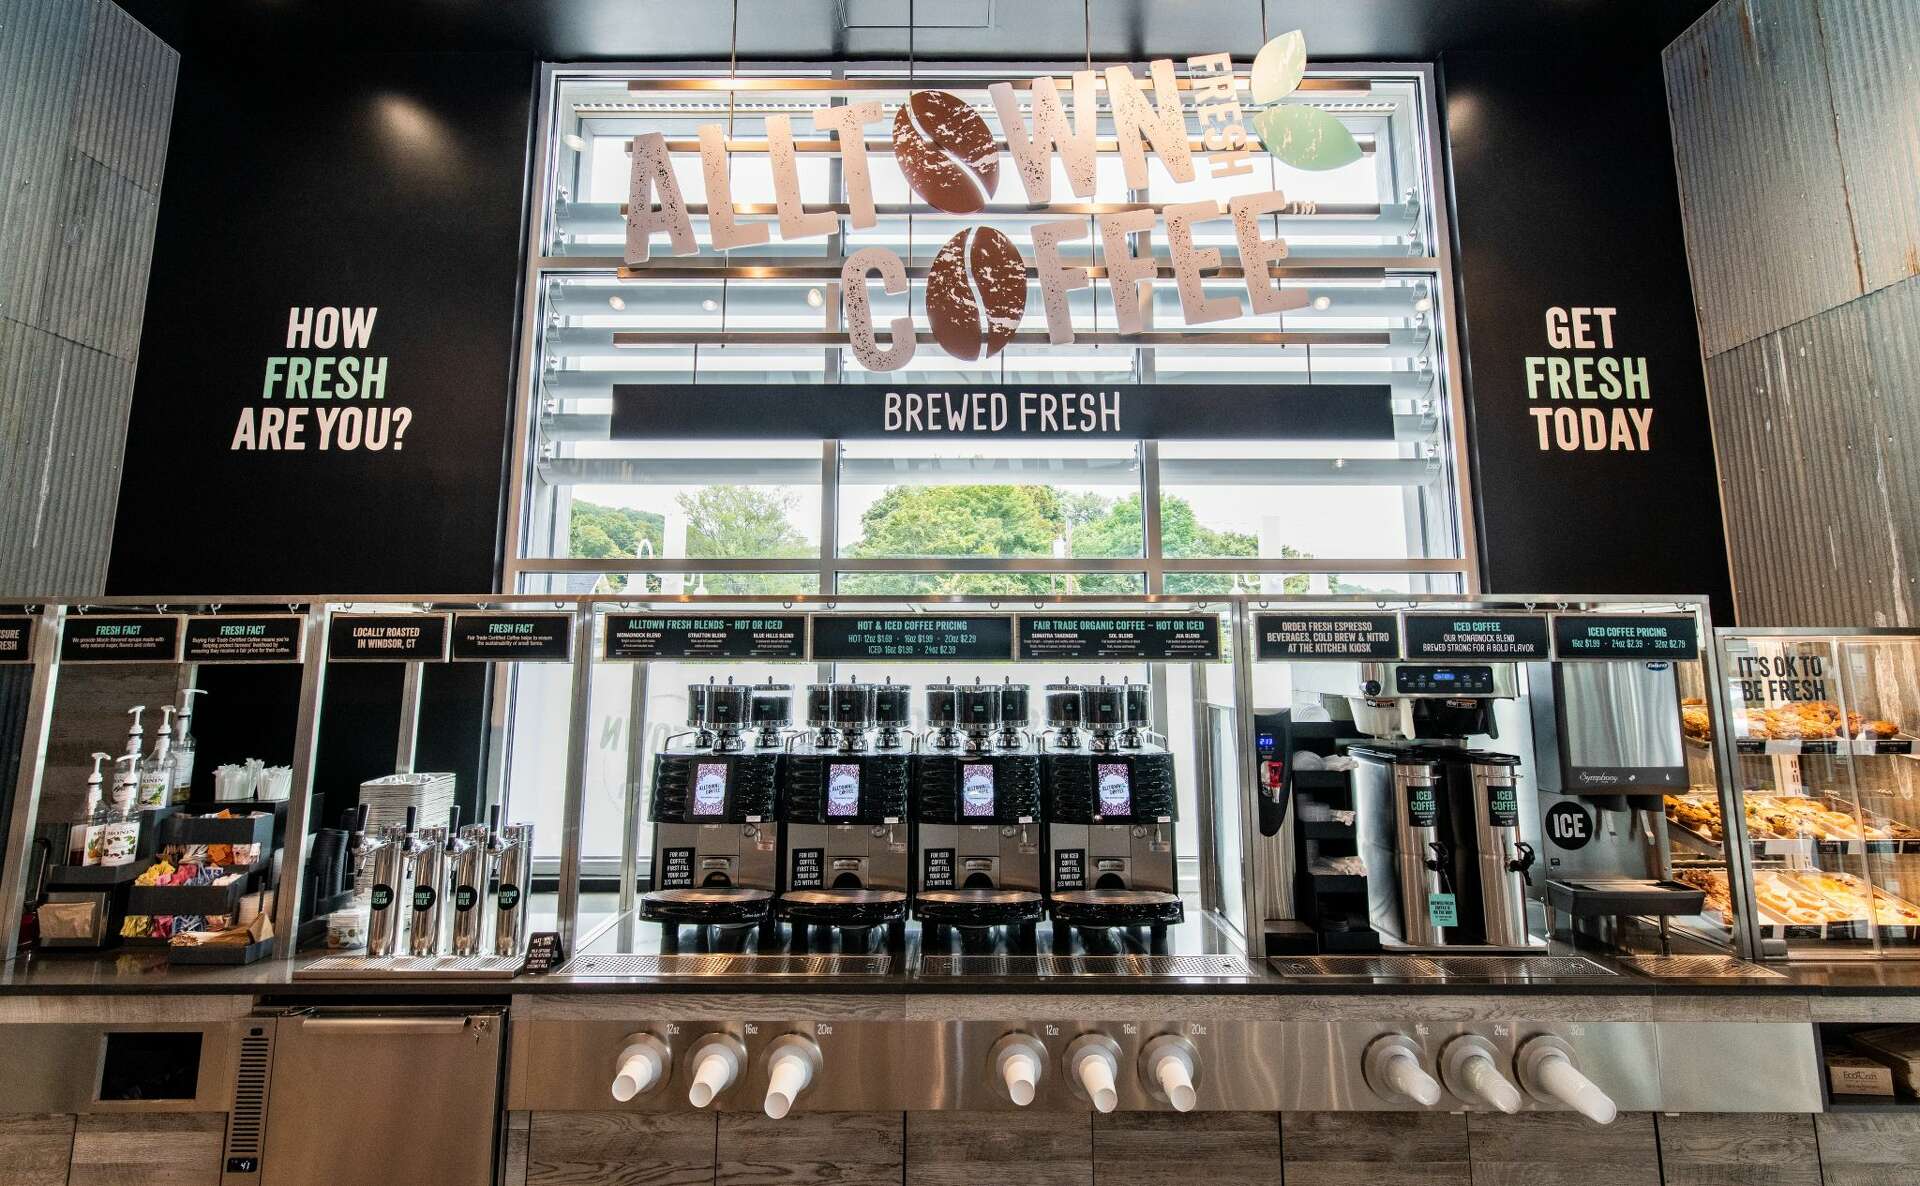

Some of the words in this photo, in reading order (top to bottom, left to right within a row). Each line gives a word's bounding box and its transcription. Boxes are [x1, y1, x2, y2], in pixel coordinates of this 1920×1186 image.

[286, 306, 378, 349] HOW
[1545, 306, 1617, 349] GET
[262, 356, 388, 399] FRESH
[1525, 356, 1650, 400] FRESH
[884, 392, 1008, 432] BREWED
[1020, 392, 1120, 432] FRESH
[230, 407, 309, 451] ARE
[316, 407, 412, 451] YOU?
[1529, 407, 1653, 451] TODAY
[220, 625, 245, 635] FRESH
[246, 625, 266, 635] FACT
[488, 623, 513, 633] FRESH
[515, 623, 534, 633] FACT
[628, 619, 665, 630] ALLTOWN
[666, 619, 692, 630] FRESH
[694, 619, 725, 630] BLENDS
[734, 619, 750, 630] HOT
[752, 619, 763, 630] OR
[764, 619, 783, 630] ICED
[857, 621, 873, 631] HOT
[875, 621, 882, 631] &
[884, 621, 903, 631] ICED
[904, 621, 933, 631] COFFEE
[935, 621, 967, 631] PRICING
[1033, 620, 1051, 630] FAIR
[1053, 620, 1078, 630] TRADE
[1079, 620, 1115, 630] ORGANIC
[1116, 620, 1146, 630] COFFEE
[1156, 620, 1172, 630] HOT
[1173, 620, 1184, 630] OR
[1186, 620, 1205, 630] ICED
[1281, 622, 1307, 632] ORDER
[1308, 622, 1332, 632] FRESH
[1334, 622, 1372, 632] ESPRESSO
[1453, 622, 1471, 632] ICED
[1472, 622, 1501, 632] COFFEE
[96, 626, 120, 635] FRESH
[122, 626, 142, 635] FACT
[353, 627, 385, 637] LOCALLY
[386, 627, 420, 637] ROASTED
[1587, 627, 1606, 637] ICED
[1606, 627, 1635, 637] COFFEE
[1636, 627, 1668, 637] PRICING
[864, 634, 876, 643] 12oz
[1266, 632, 1311, 642] BEVERAGES,
[1312, 632, 1332, 642] COLD
[1334, 632, 1355, 642] BREW
[1358, 632, 1365, 642] &
[1366, 632, 1389, 642] NITRO
[1443, 634, 1456, 643] OUR
[1496, 634, 1515, 643] BLEND
[357, 639, 366, 649] IN
[367, 639, 405, 649] WINDSOR,
[406, 639, 416, 649] CT
[925, 645, 938, 654] 24oz
[1287, 643, 1296, 653] AT
[1299, 643, 1313, 653] THE
[1315, 643, 1347, 653] KITCHEN
[1348, 643, 1371, 653] KIOSK
[1423, 644, 1446, 652] BREWED
[1447, 644, 1472, 652] STRONG
[1473, 644, 1485, 652] FOR
[1486, 644, 1492, 652] A
[1493, 644, 1509, 652] BOLD
[1510, 644, 1535, 652] FLAVOR
[1611, 640, 1625, 649] 24oz
[1654, 640, 1668, 649] 32oz
[1737, 655, 1771, 678] IT'S
[1775, 655, 1798, 678] OK
[1799, 655, 1822, 678] TO
[1741, 680, 1765, 701] BE
[1768, 680, 1826, 701] FRESH
[1579, 771, 1618, 784] Symphony
[1416, 790, 1432, 801] ICED
[1496, 790, 1513, 800] ICED
[1410, 800, 1436, 811] COFFEE
[1491, 800, 1517, 811] COFFEE
[1553, 813, 1586, 838] ICE
[666, 1023, 680, 1035] 12oz
[744, 1023, 759, 1035] 16oz
[817, 1023, 833, 1035] 20oz
[1045, 1024, 1059, 1036] 12oz
[1123, 1023, 1137, 1035] 16oz
[1191, 1023, 1207, 1035] 20oz
[1494, 1024, 1508, 1036] 24oz
